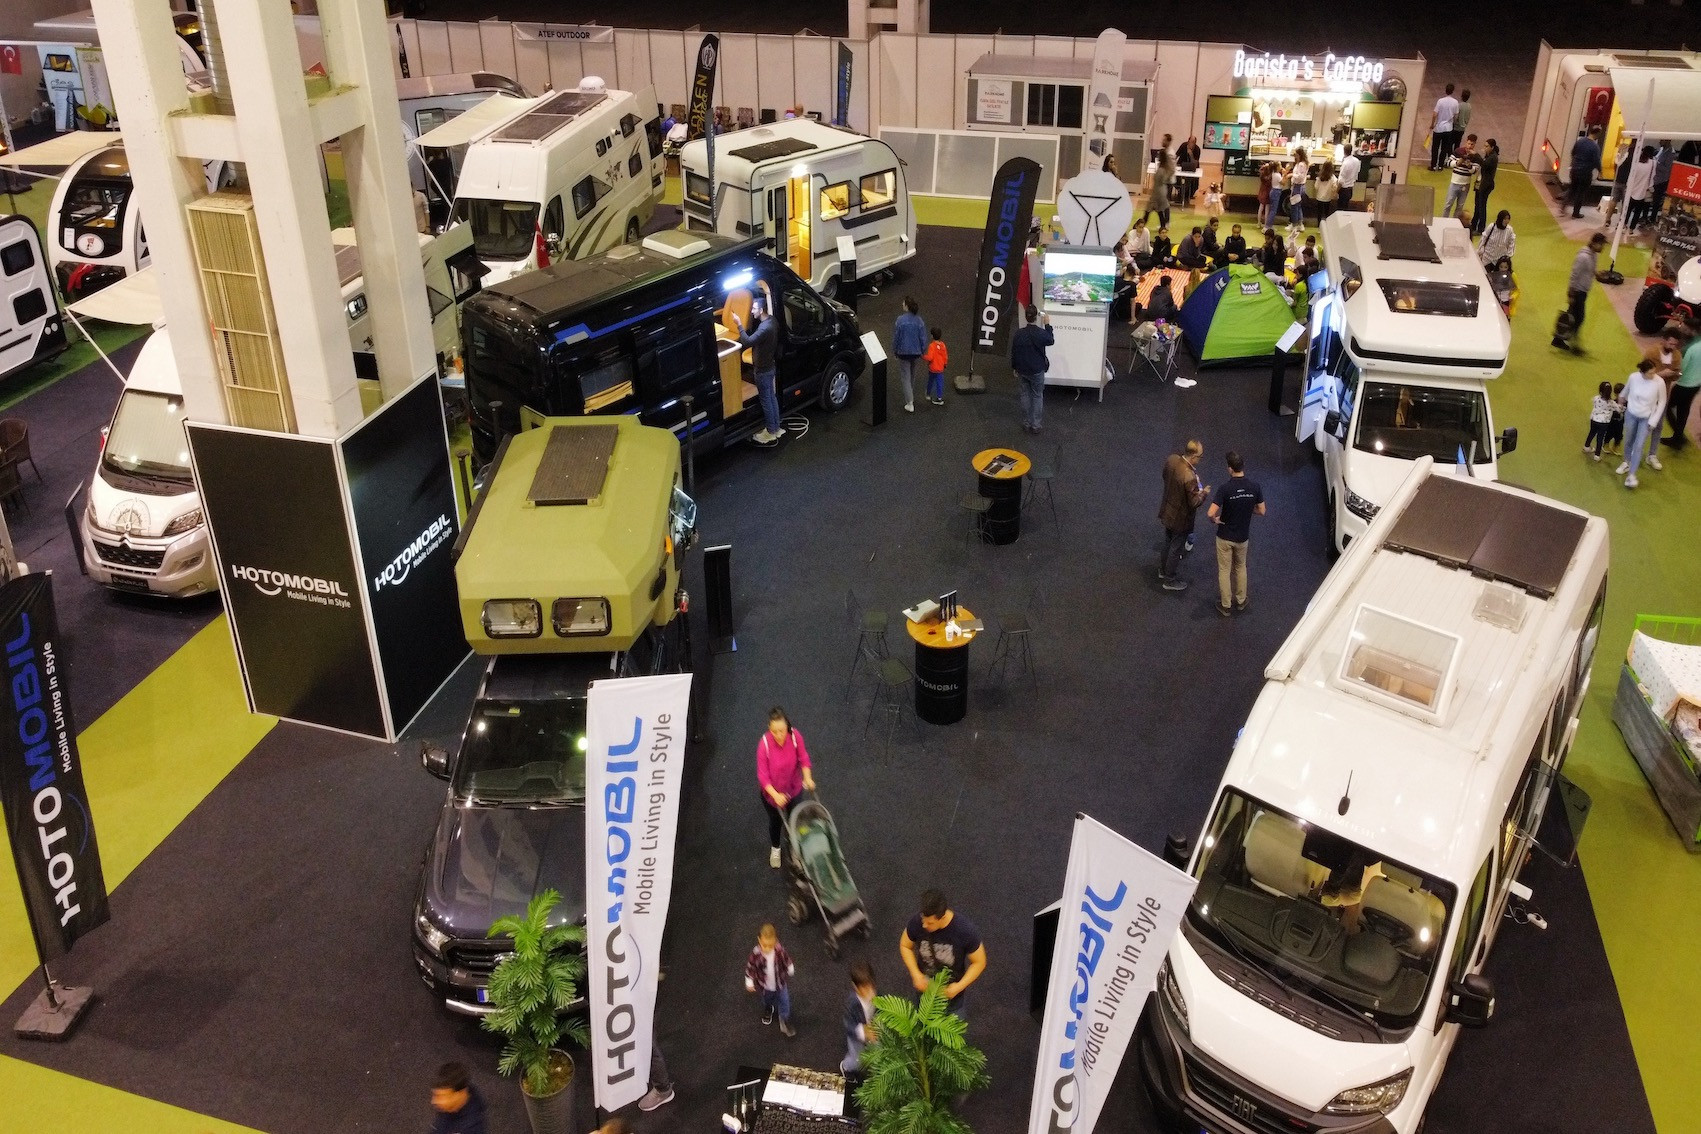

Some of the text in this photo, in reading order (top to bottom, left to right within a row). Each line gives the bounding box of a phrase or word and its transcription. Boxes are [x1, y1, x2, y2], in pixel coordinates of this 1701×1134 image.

[538, 30, 591, 39] ATEF OUTDOOR
[1233, 49, 1384, 83] Barista's Coffee
[1672, 187, 1701, 200] SEGWA
[978, 170, 1025, 347] HOTOMOBIL
[231, 564, 349, 597] HOTOMOBIL
[374, 513, 451, 592] HOTOMOBIL
[286, 590, 352, 609] Mobile Living in Style
[43, 641, 73, 774] Mobile Living in Style
[5, 612, 81, 927] HOTOMOBIL
[632, 712, 672, 915] Mobile Living in Style
[1080, 896, 1162, 1078] Mobile Living in Style
[1233, 1094, 1258, 1123] FIAT
